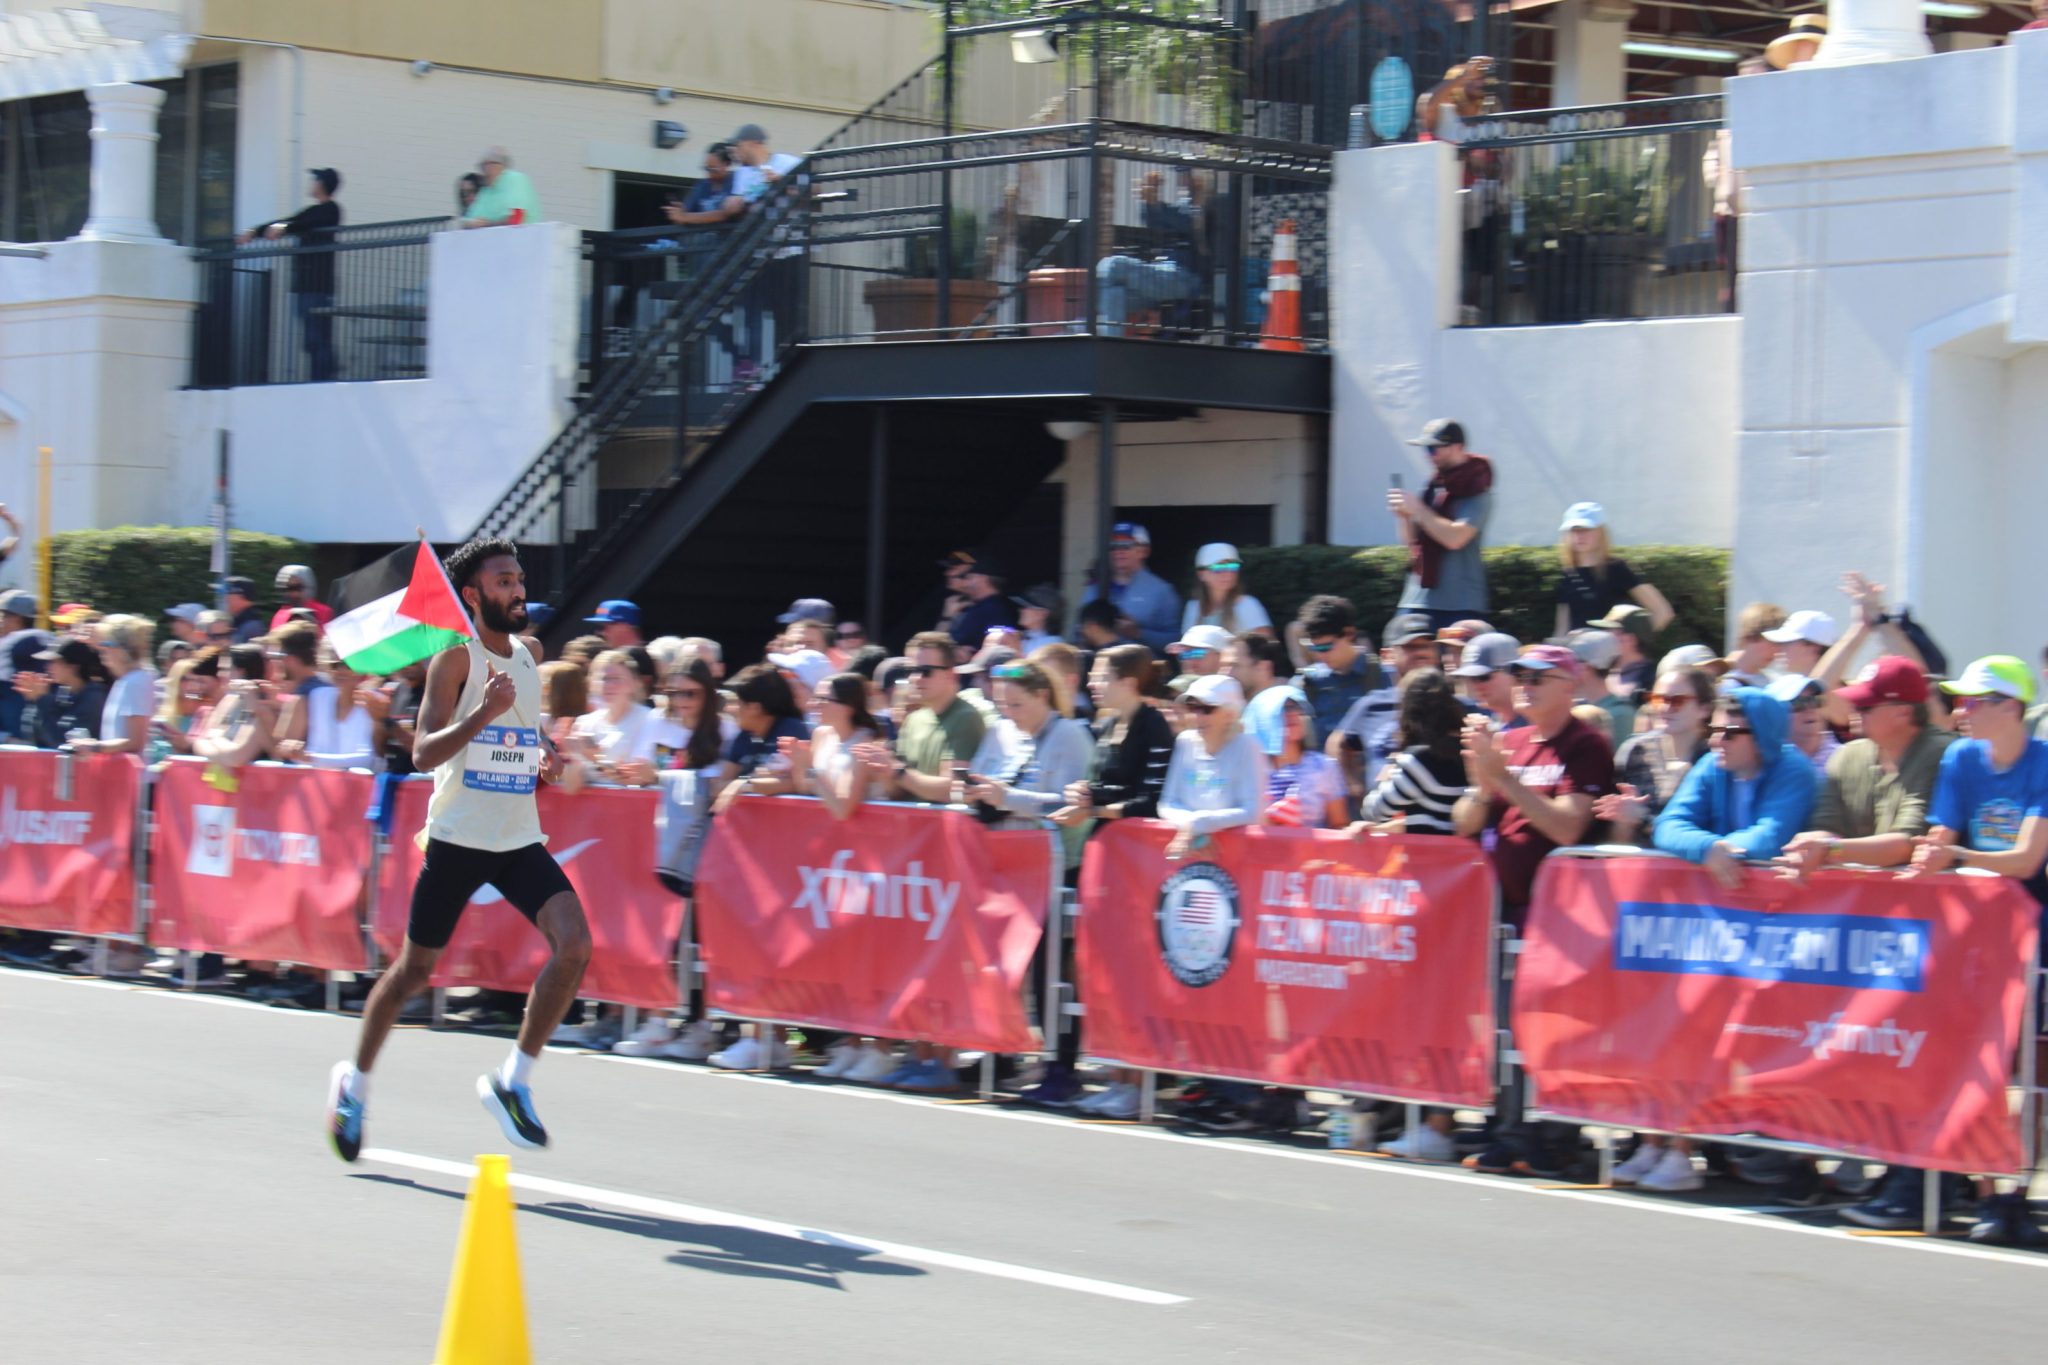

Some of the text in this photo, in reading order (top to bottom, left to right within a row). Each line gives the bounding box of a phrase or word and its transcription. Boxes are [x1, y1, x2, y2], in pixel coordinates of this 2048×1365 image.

[476, 772, 509, 784] ORLANDO
[491, 750, 524, 763] JOSEPH
[11, 810, 93, 844] USATF
[792, 849, 961, 941] xfinity
[1256, 914, 1418, 961] TEAM TRIALS
[1847, 928, 1920, 978] USA
[1801, 1011, 1927, 1068] xfinity
